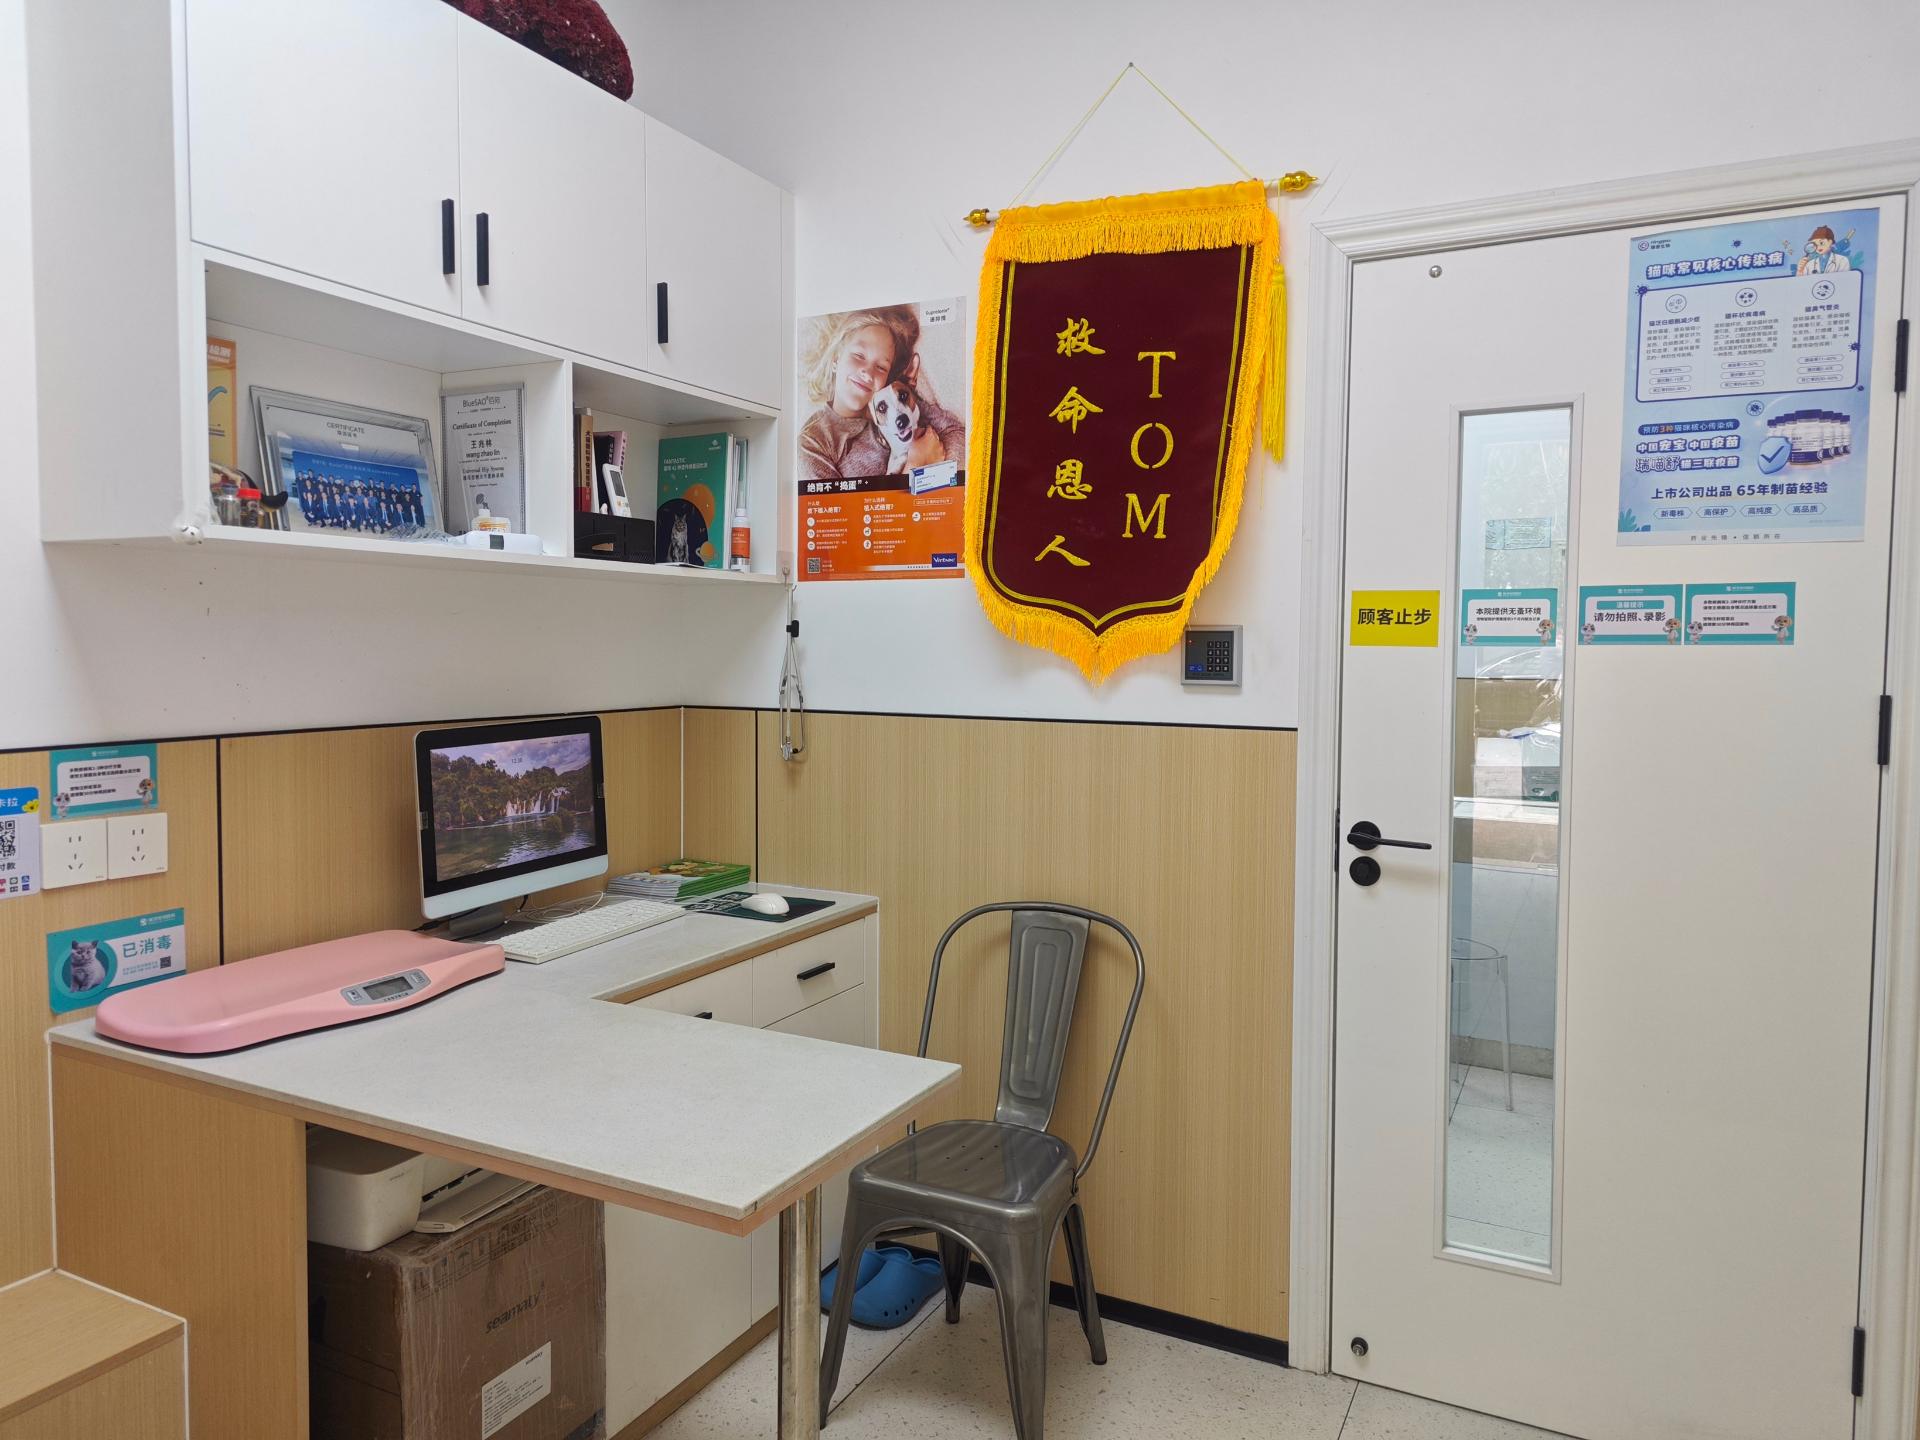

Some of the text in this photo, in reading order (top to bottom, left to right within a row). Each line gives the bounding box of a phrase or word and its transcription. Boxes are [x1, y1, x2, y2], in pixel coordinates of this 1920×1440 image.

[1647, 253, 1784, 280] 猫咪常见核心传染病
[326, 422, 365, 434] CERTIFICATE
[1643, 422, 1734, 434] 预防3种猫咪核心传染病
[1034, 317, 1106, 567] 救命恩人
[1121, 350, 1177, 539] TOM
[1637, 436, 1740, 453] 中国宠宝 中国疫苗
[1651, 481, 1828, 499] 上市公司出品 65年制苗经验
[1661, 509, 1684, 517] 新毒株
[1704, 508, 1728, 516] 高保护
[1748, 506, 1772, 515] 高纯度
[1793, 505, 1819, 513] 高品质
[1357, 607, 1431, 625] 顾客止步
[1476, 607, 1542, 615] 本院提供无蚤环境
[1594, 611, 1666, 622] 请勿拍照、录影
[122, 935, 172, 958] 已消毒
[486, 1294, 540, 1334] seamaty
